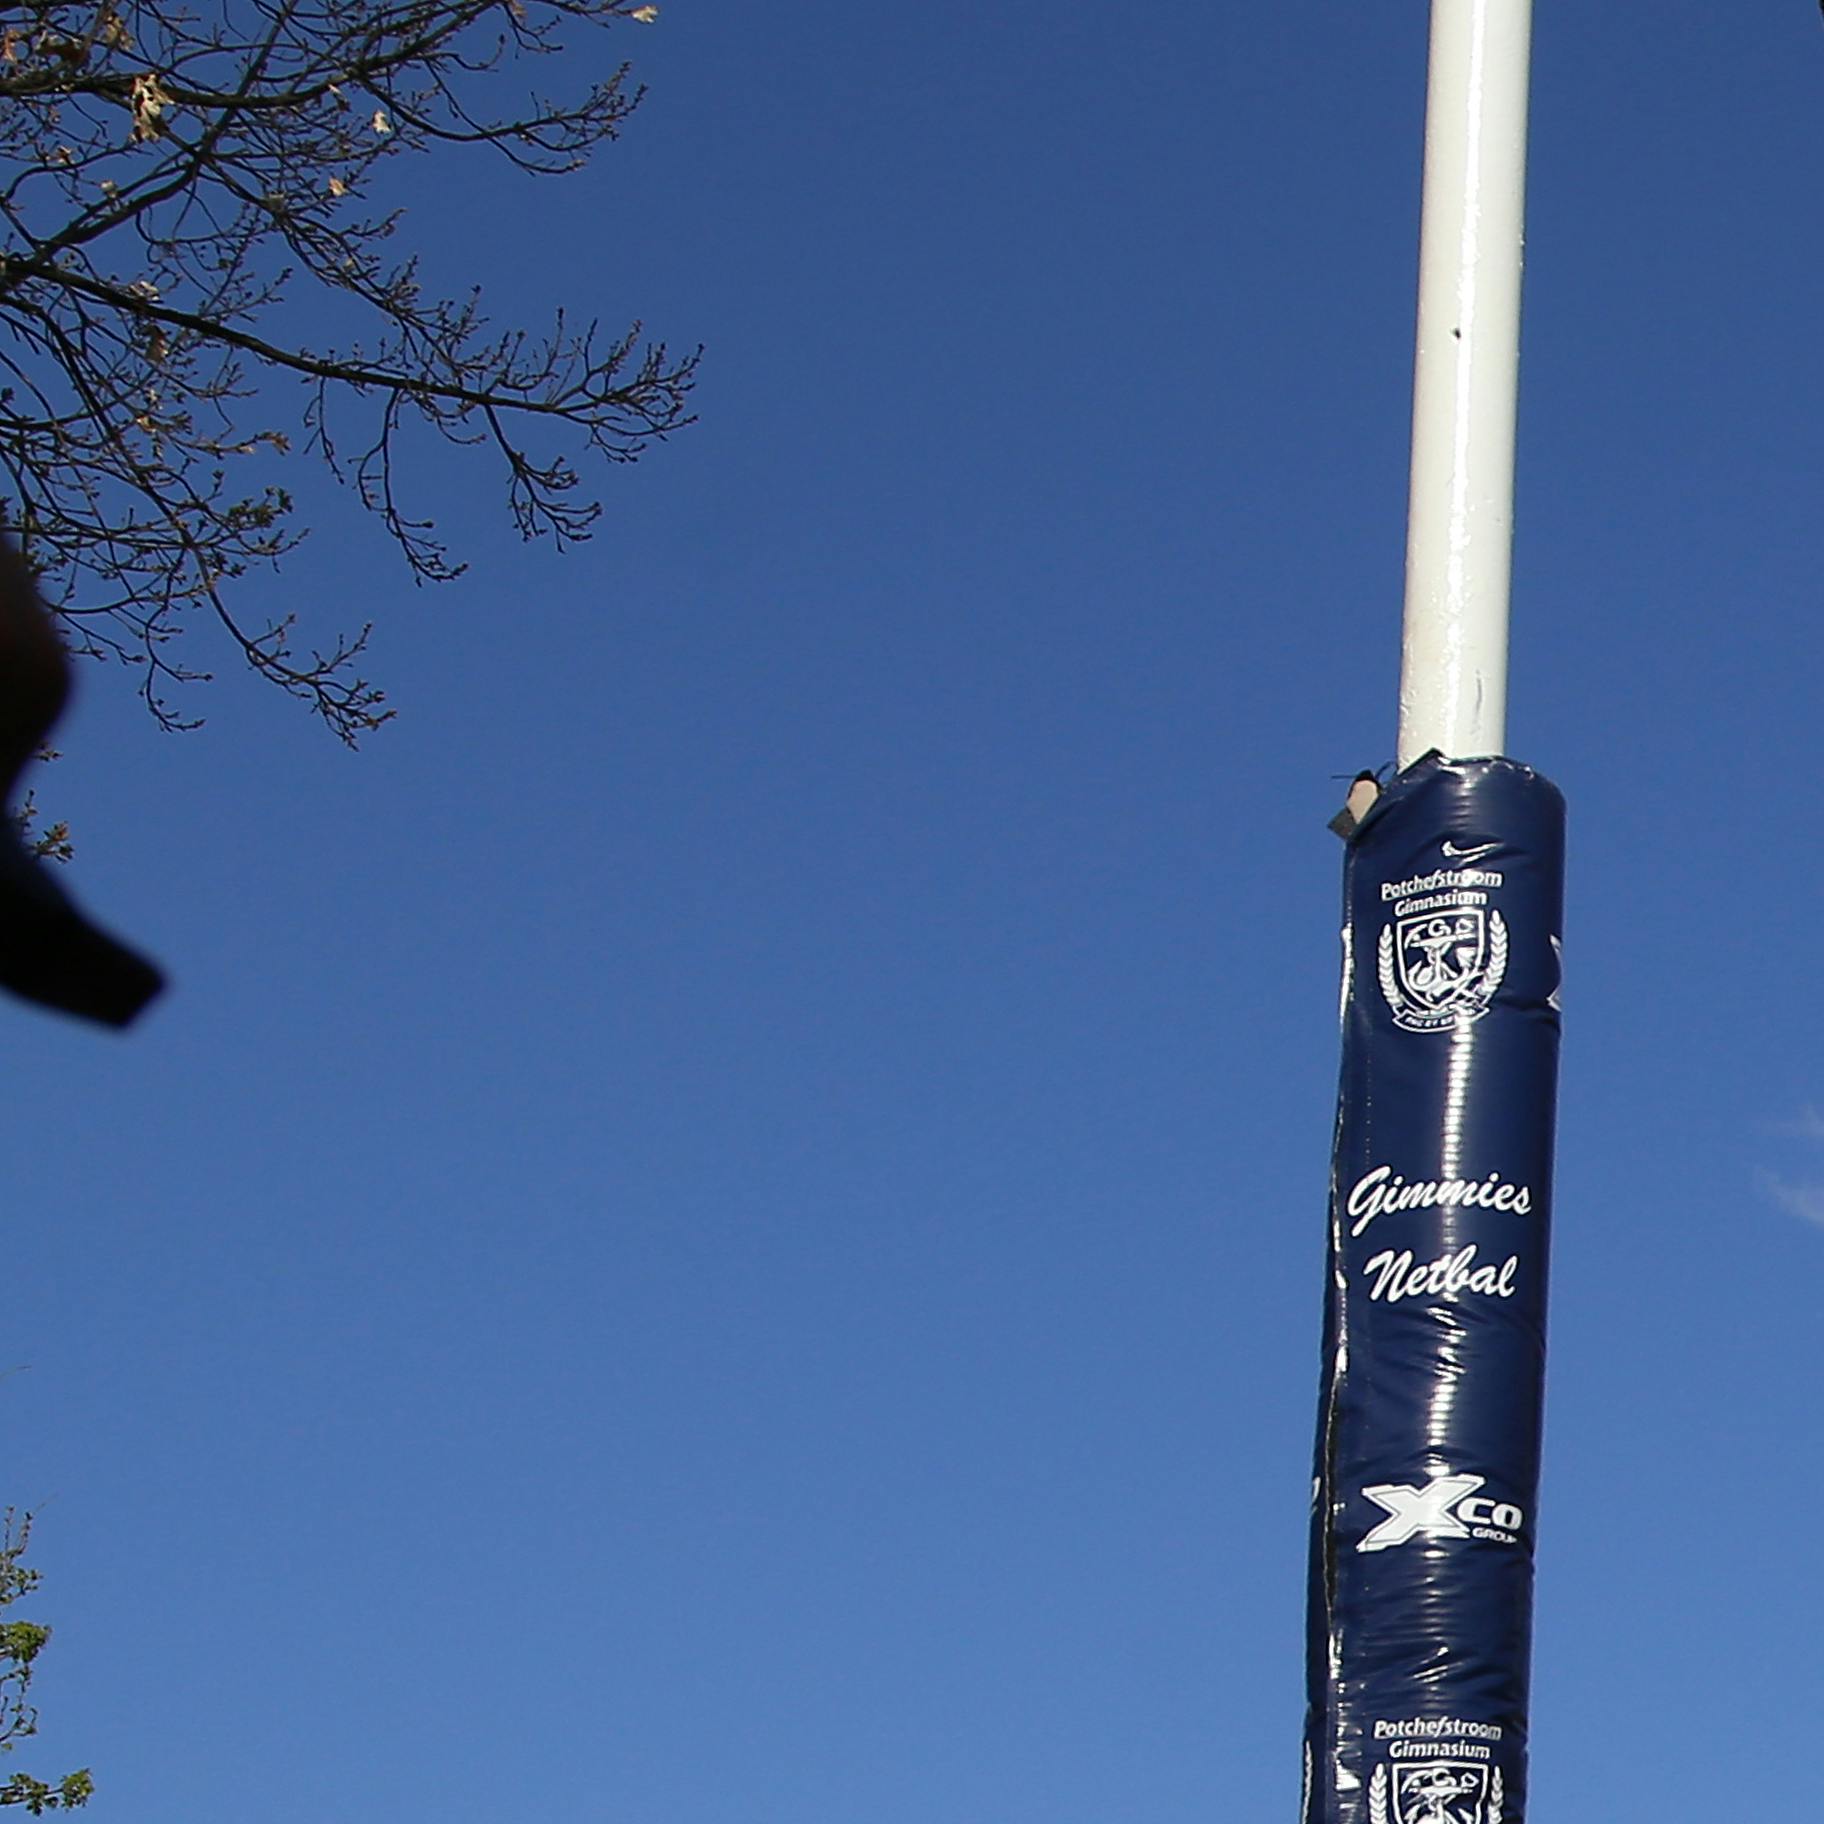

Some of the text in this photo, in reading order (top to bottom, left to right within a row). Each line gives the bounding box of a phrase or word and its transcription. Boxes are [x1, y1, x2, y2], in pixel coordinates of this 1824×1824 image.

[1395, 889, 1487, 917] Gimnasium
[1347, 1165, 1532, 1237] Gimmies
[1363, 1244, 1518, 1302] Netbal
[1374, 1715, 1502, 1740] Potchefstroom
[1389, 1739, 1491, 1759] Gimnasium
